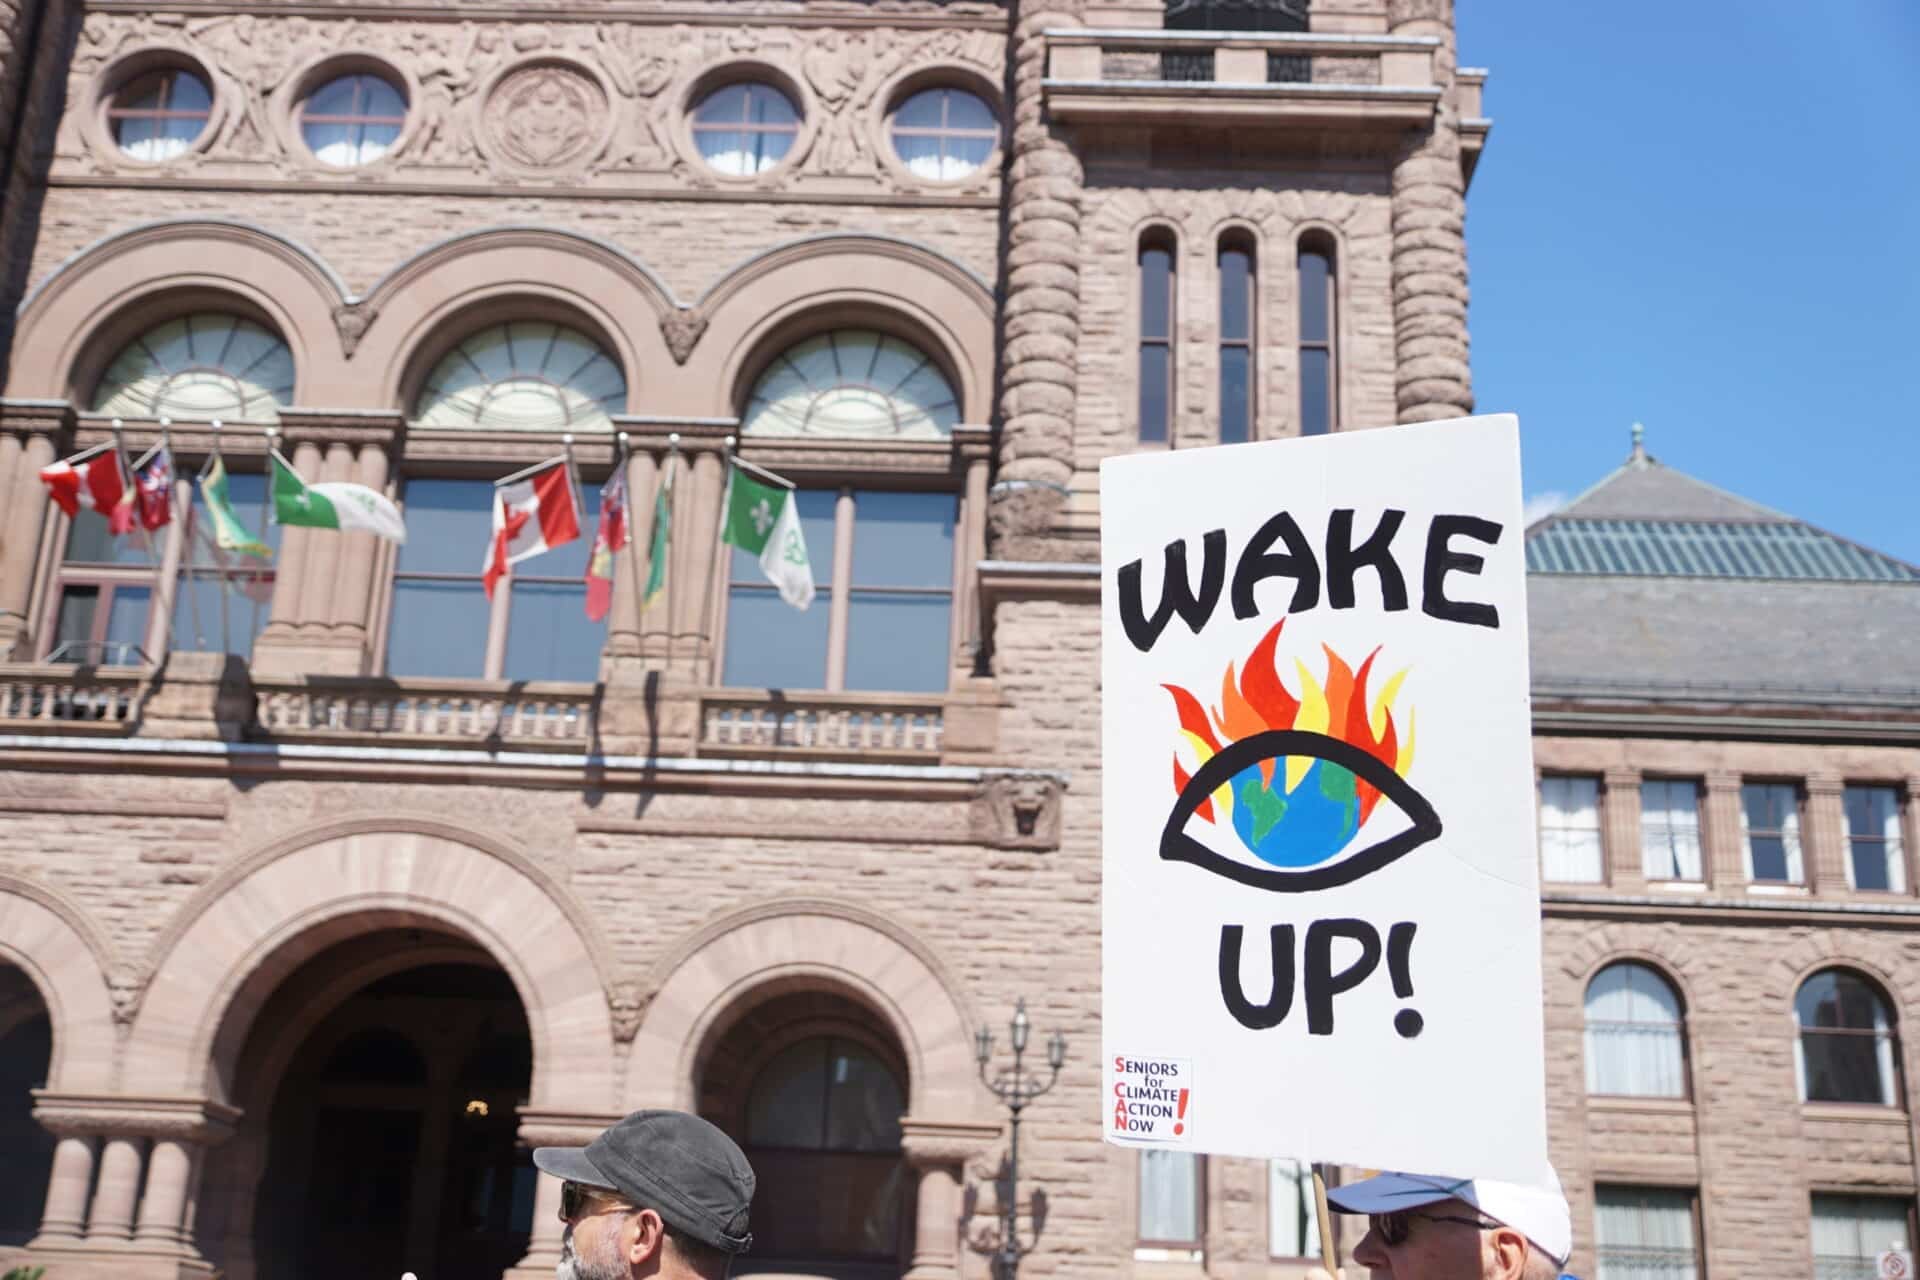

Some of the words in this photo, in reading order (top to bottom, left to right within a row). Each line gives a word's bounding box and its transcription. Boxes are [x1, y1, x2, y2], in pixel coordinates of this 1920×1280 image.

[1118, 509, 1504, 652] WAKE
[1219, 918, 1424, 1039] UP!
[1115, 1057, 1178, 1076] SENIORS
[1144, 1074, 1164, 1088] for
[1114, 1082, 1178, 1102] CLIMATE
[1115, 1099, 1173, 1118] ACTION
[1115, 1115, 1154, 1132] NOW
